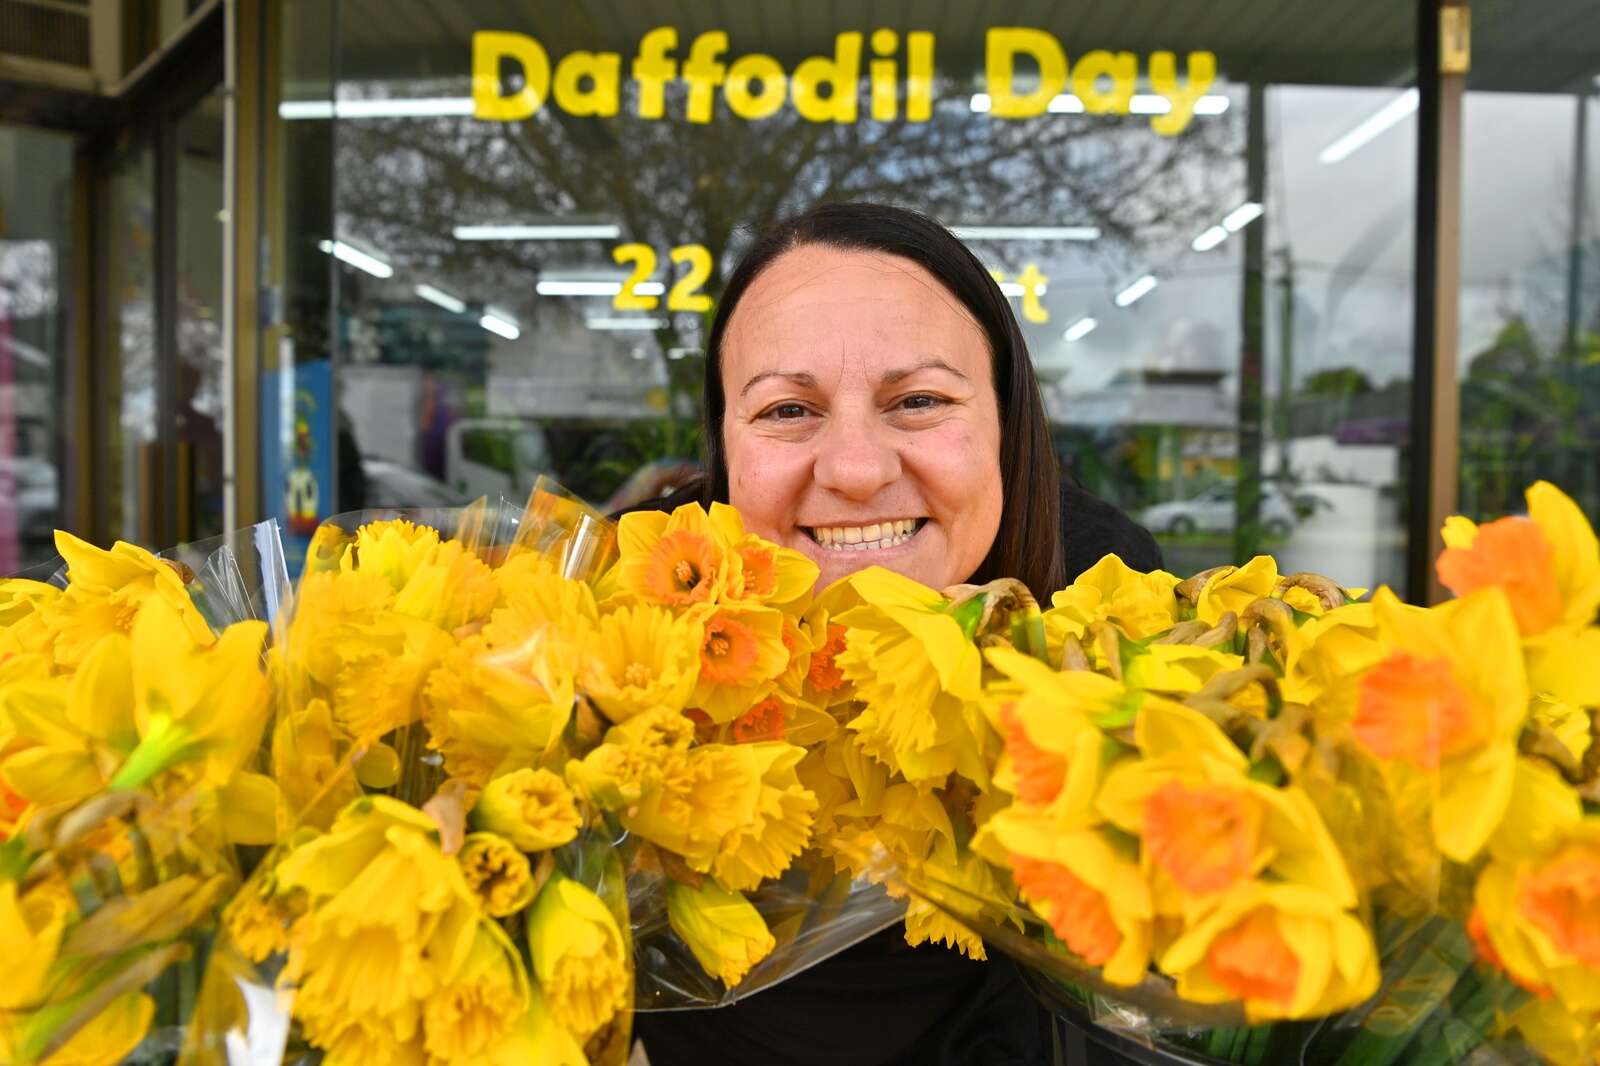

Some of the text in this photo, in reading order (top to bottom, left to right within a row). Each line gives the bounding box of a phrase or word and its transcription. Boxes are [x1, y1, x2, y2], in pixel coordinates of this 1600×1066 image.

[471, 26, 1217, 136] Daffodil Day
[612, 243, 715, 312] 22
